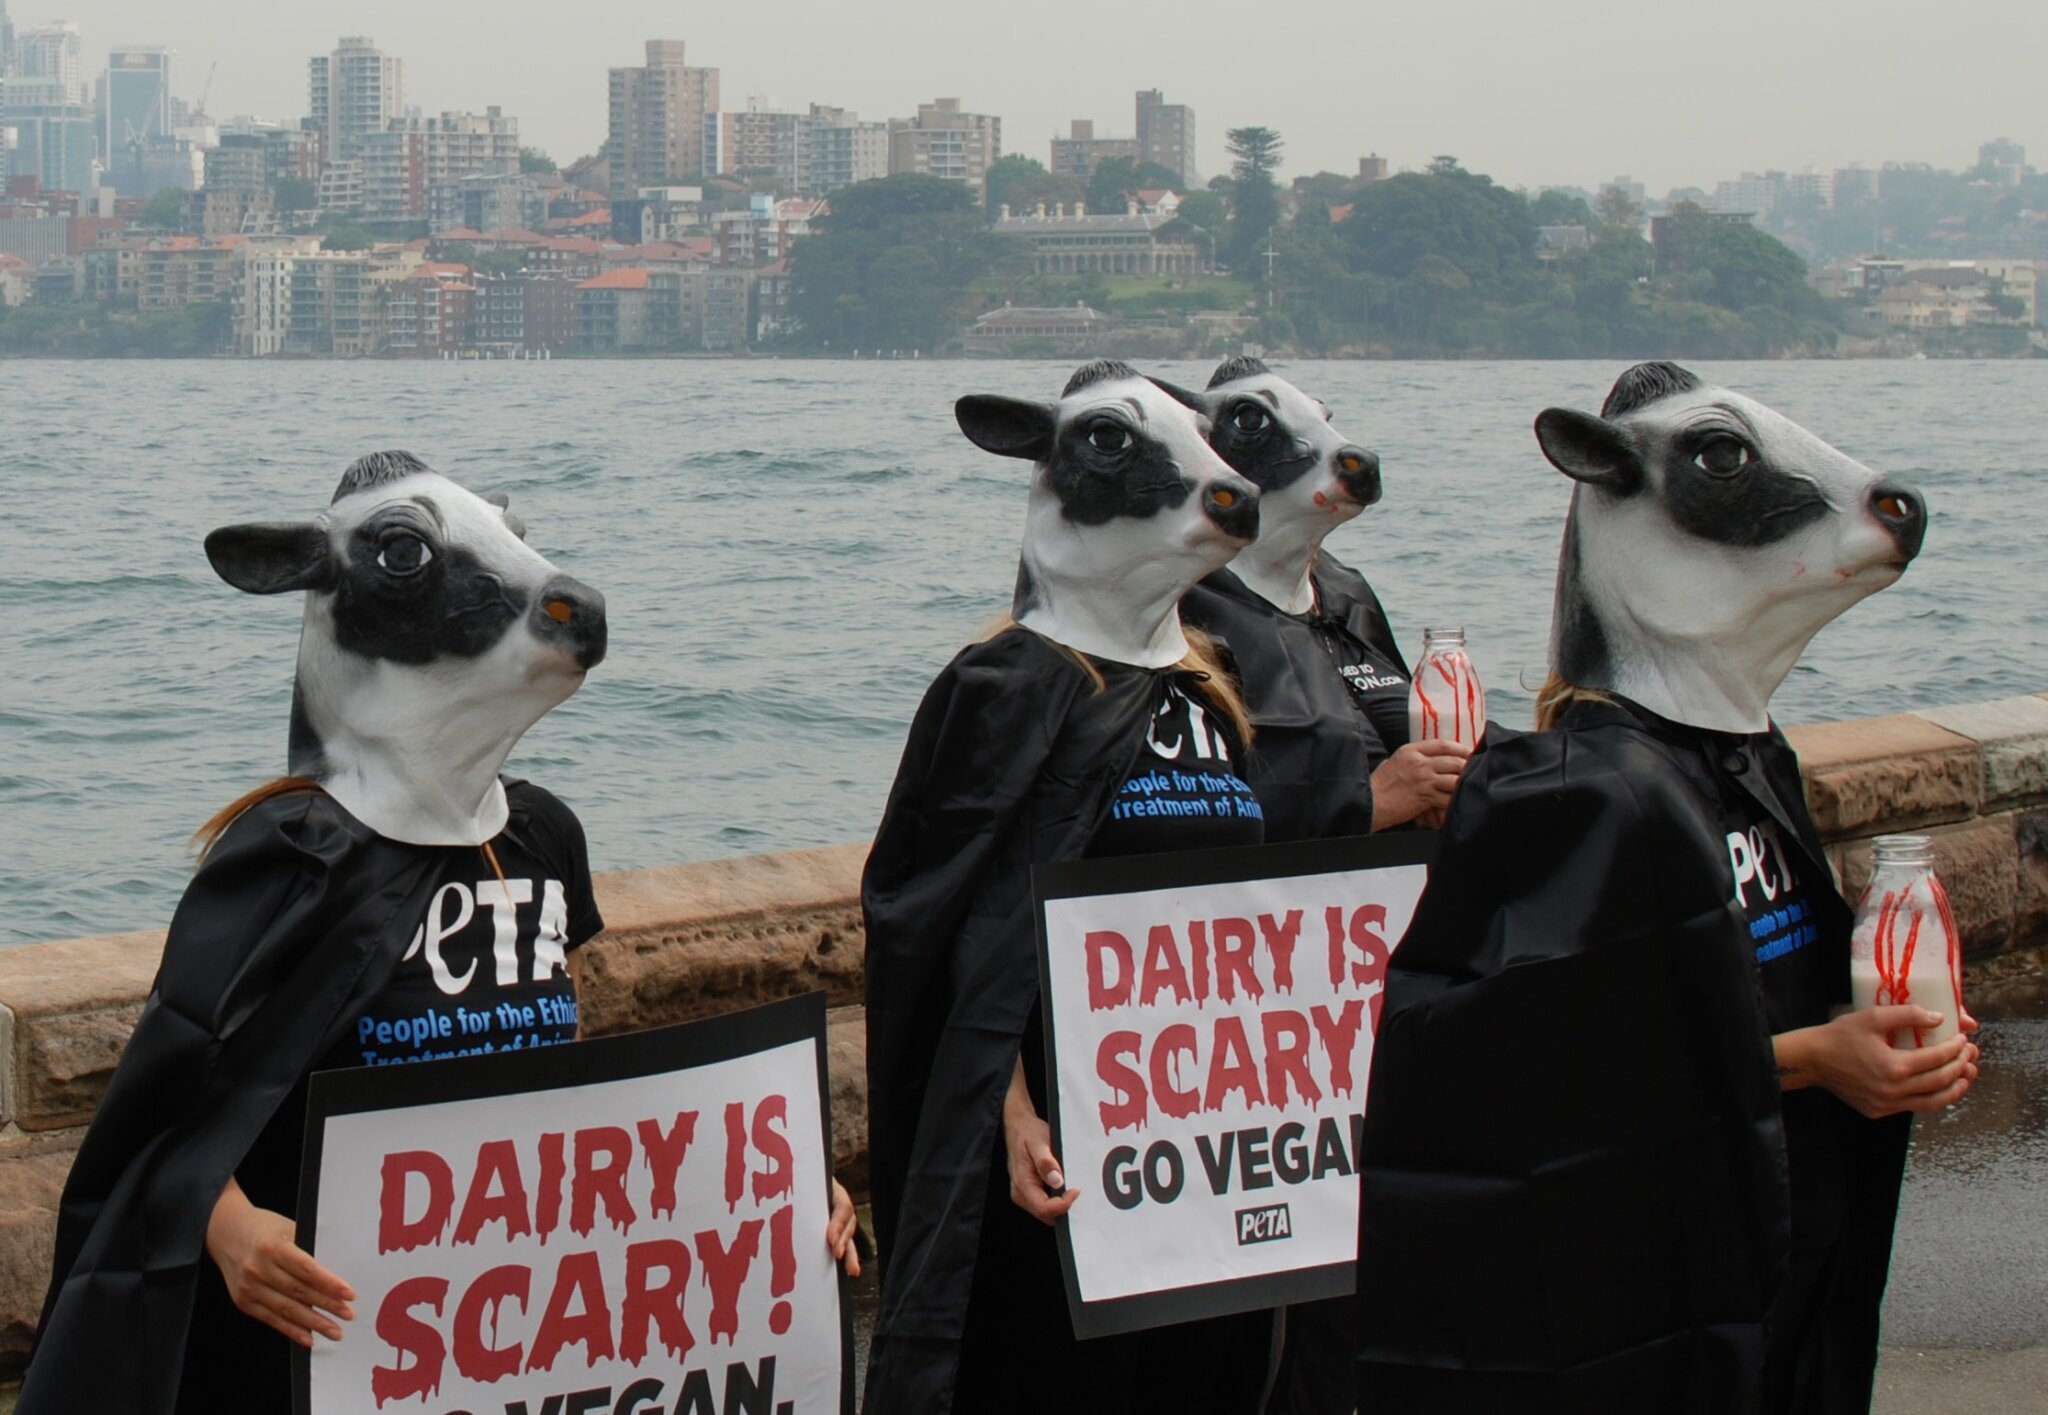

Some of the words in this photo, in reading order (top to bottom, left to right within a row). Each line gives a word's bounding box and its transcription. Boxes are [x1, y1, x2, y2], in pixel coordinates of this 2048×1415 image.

[1172, 770, 1198, 793] for
[1199, 772, 1230, 793] the
[1214, 795, 1232, 817] of
[1085, 908, 1304, 1012] DAIRY
[1325, 903, 1390, 994] IS
[357, 1008, 453, 1049] People
[457, 1006, 492, 1034] for
[496, 1002, 536, 1030] the
[378, 1110, 700, 1256] DAIRY
[723, 1094, 795, 1215] IS
[1102, 1138, 1185, 1210] GO
[371, 1204, 797, 1410] SCARY!
